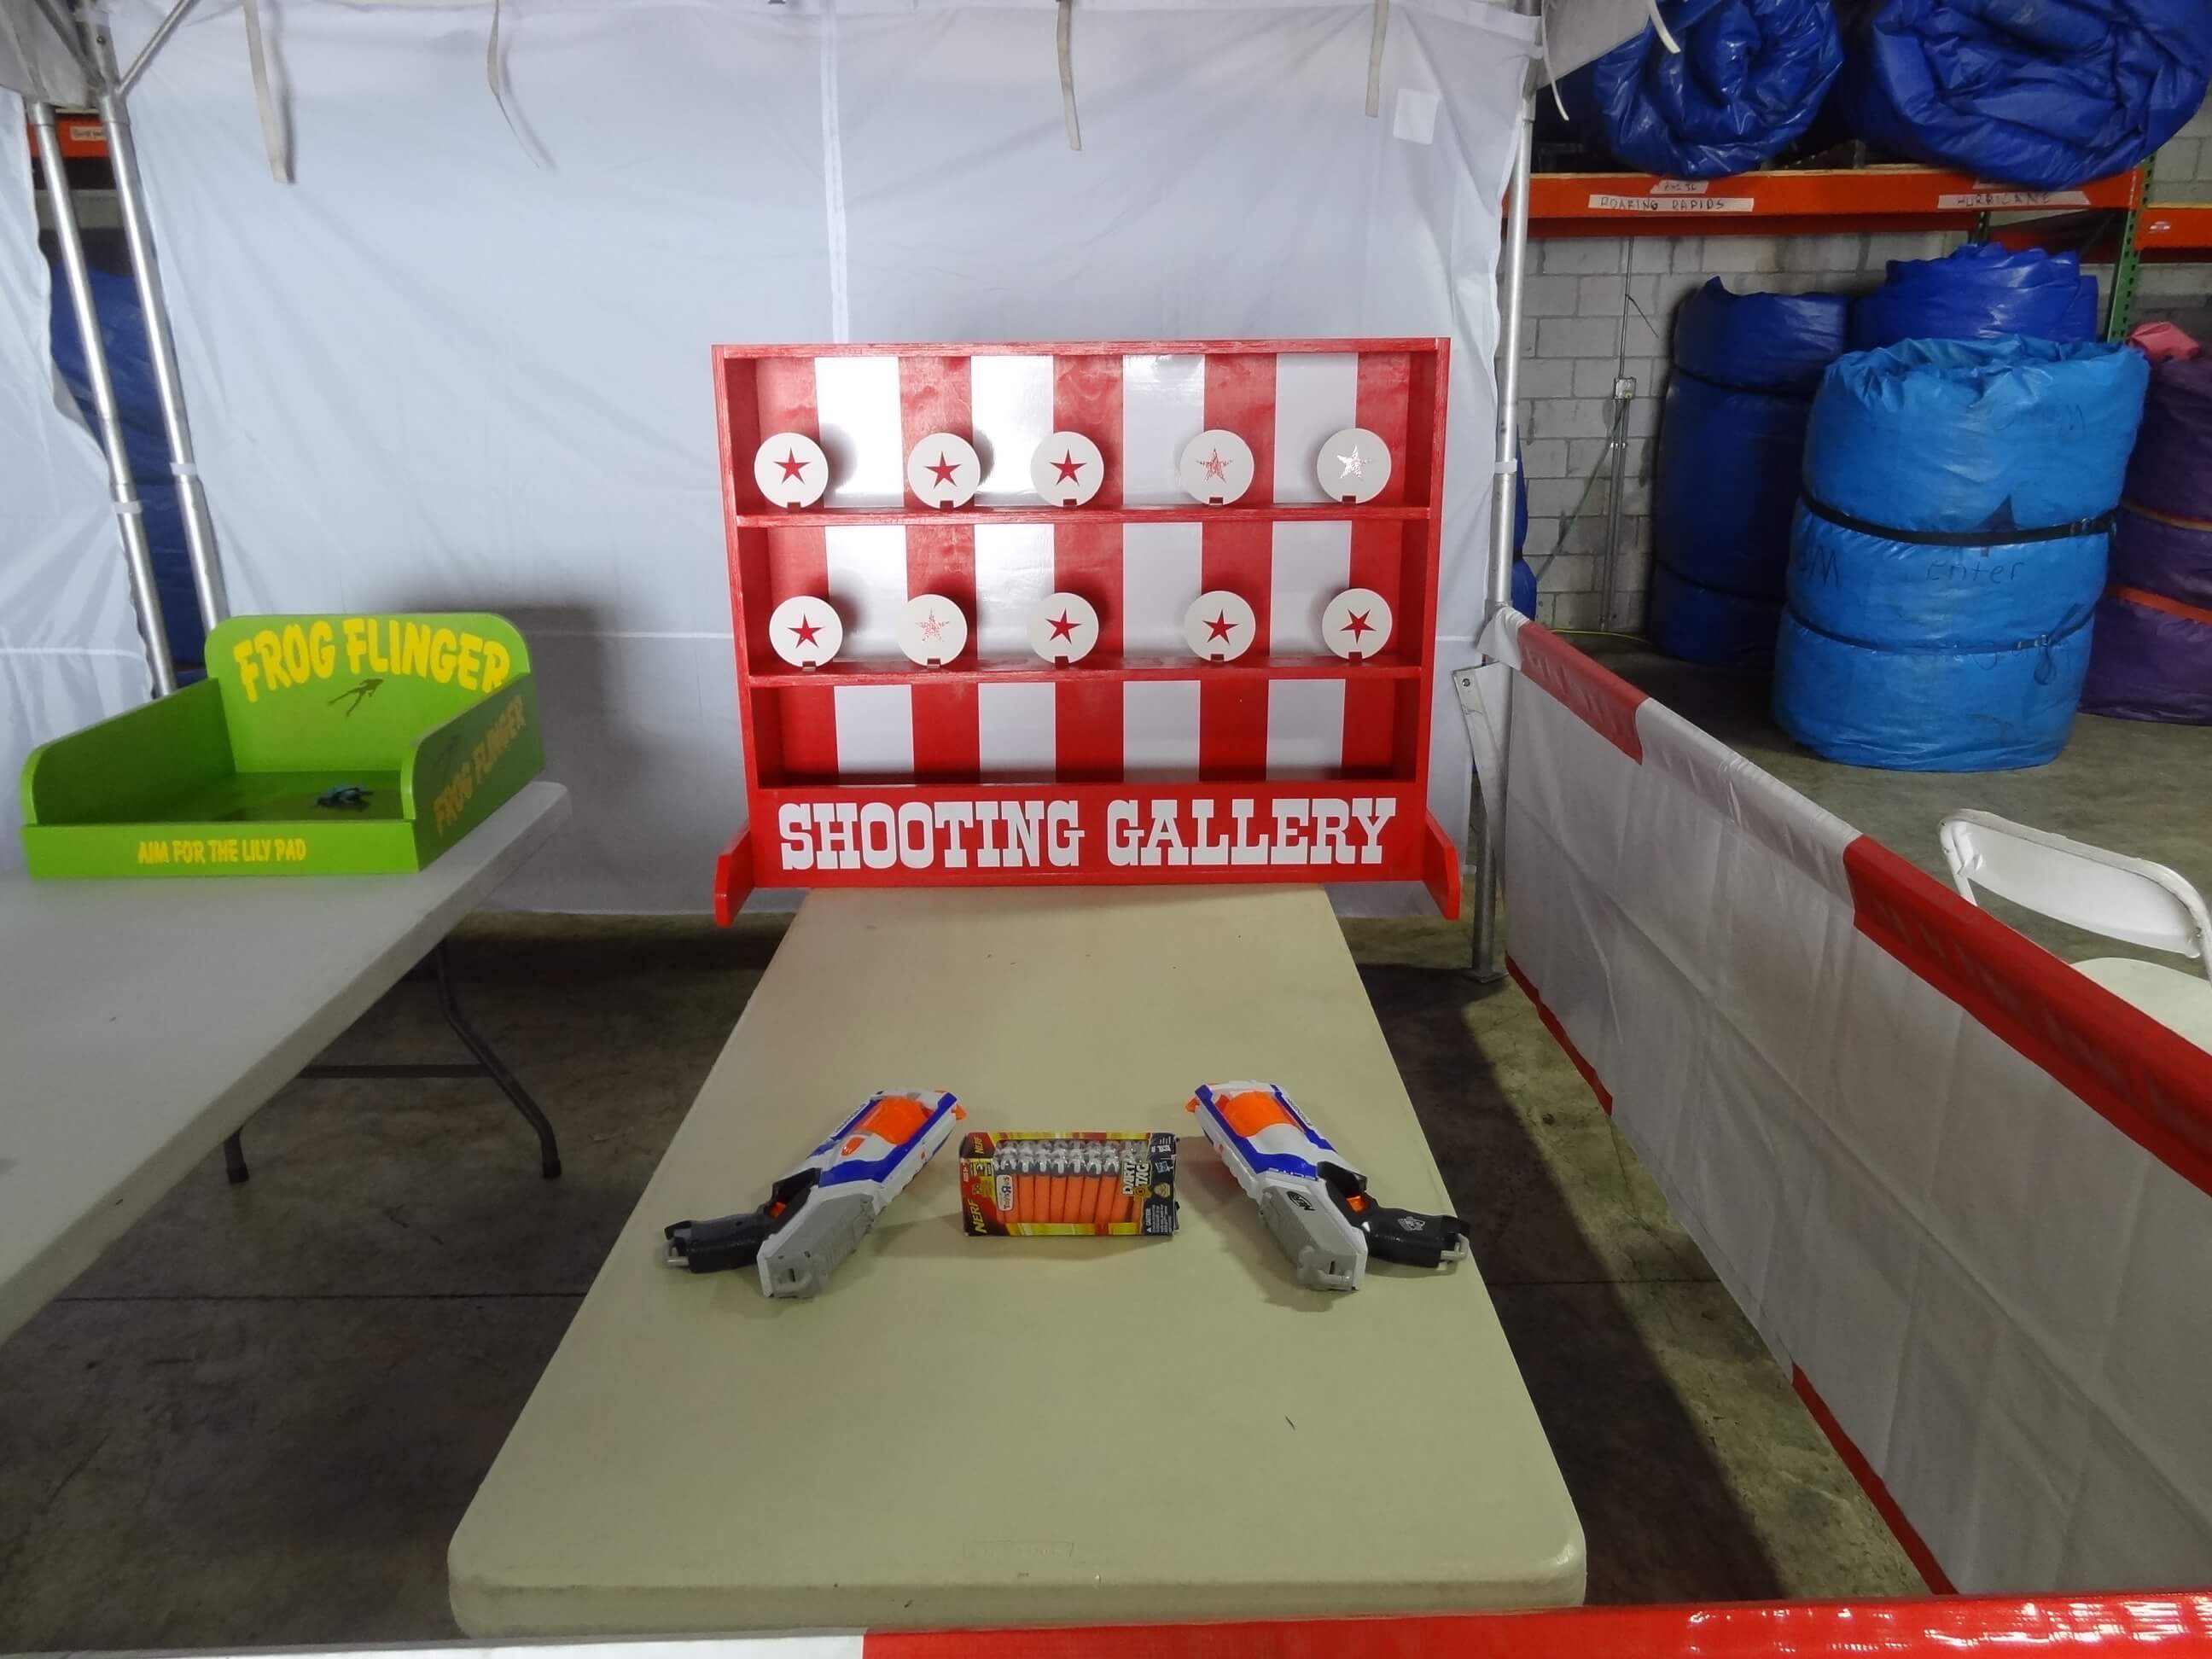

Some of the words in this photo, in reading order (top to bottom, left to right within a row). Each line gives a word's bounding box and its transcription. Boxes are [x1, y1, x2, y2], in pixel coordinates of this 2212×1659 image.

[1599, 196, 1659, 211] ROARING
[1672, 198, 1726, 211] RAPIDS
[233, 620, 335, 702] FROG
[343, 618, 510, 693] FLINGER
[172, 840, 206, 864] FOR
[207, 839, 239, 862] THE
[274, 838, 307, 861] PAD
[777, 800, 1085, 870] SHOOTING
[1107, 798, 1396, 866] GALLERY
[1122, 1161, 1135, 1195] DART
[1135, 1162, 1150, 1186] TAG
[968, 1198, 987, 1233] NERF
